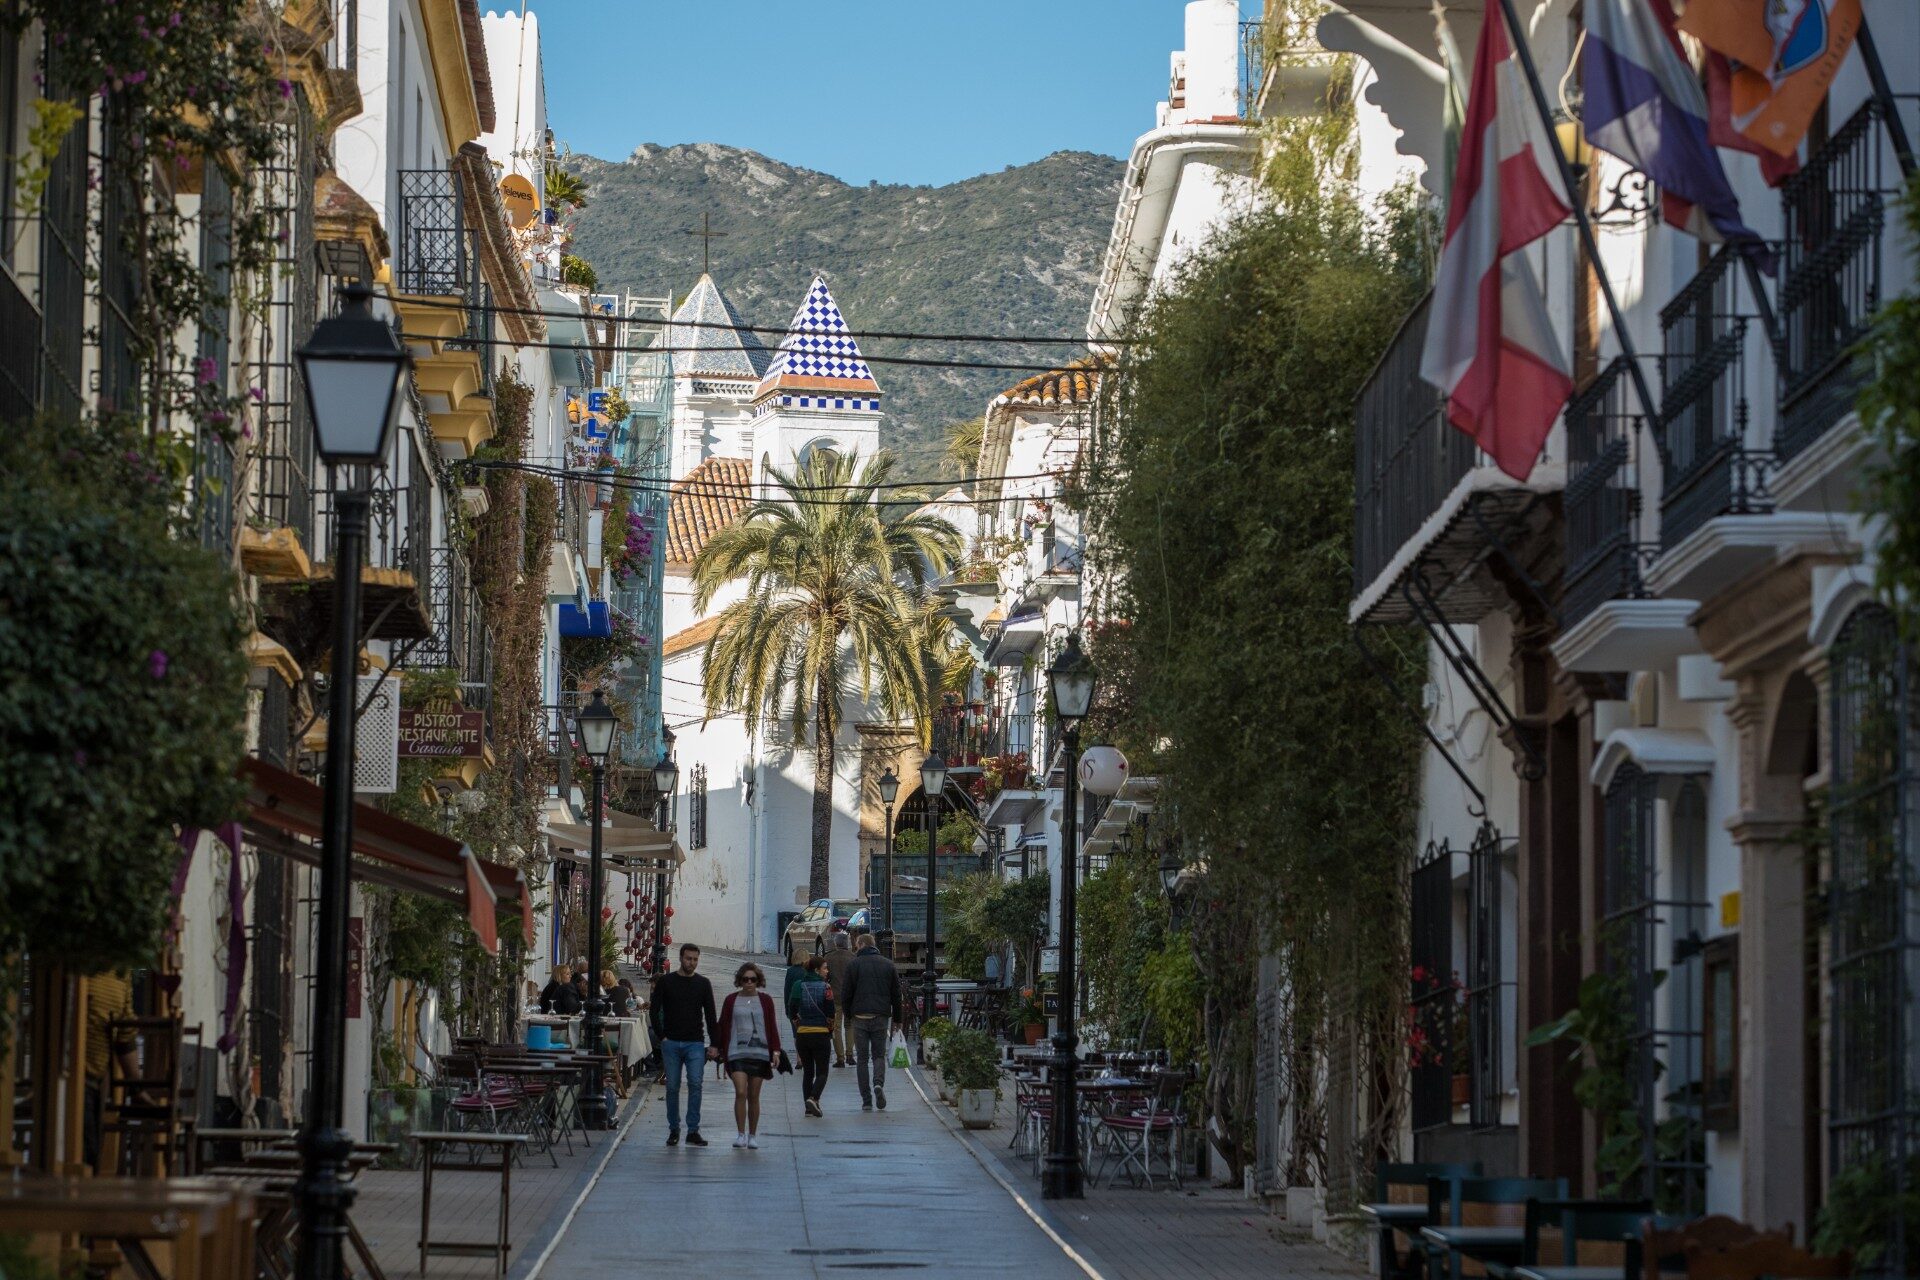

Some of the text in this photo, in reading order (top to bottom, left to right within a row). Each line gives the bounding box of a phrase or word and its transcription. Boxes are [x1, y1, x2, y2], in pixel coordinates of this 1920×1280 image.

[502, 184, 533, 201] Televes
[414, 713, 463, 727] BISTROT
[399, 728, 478, 743] RESTAURNTE
